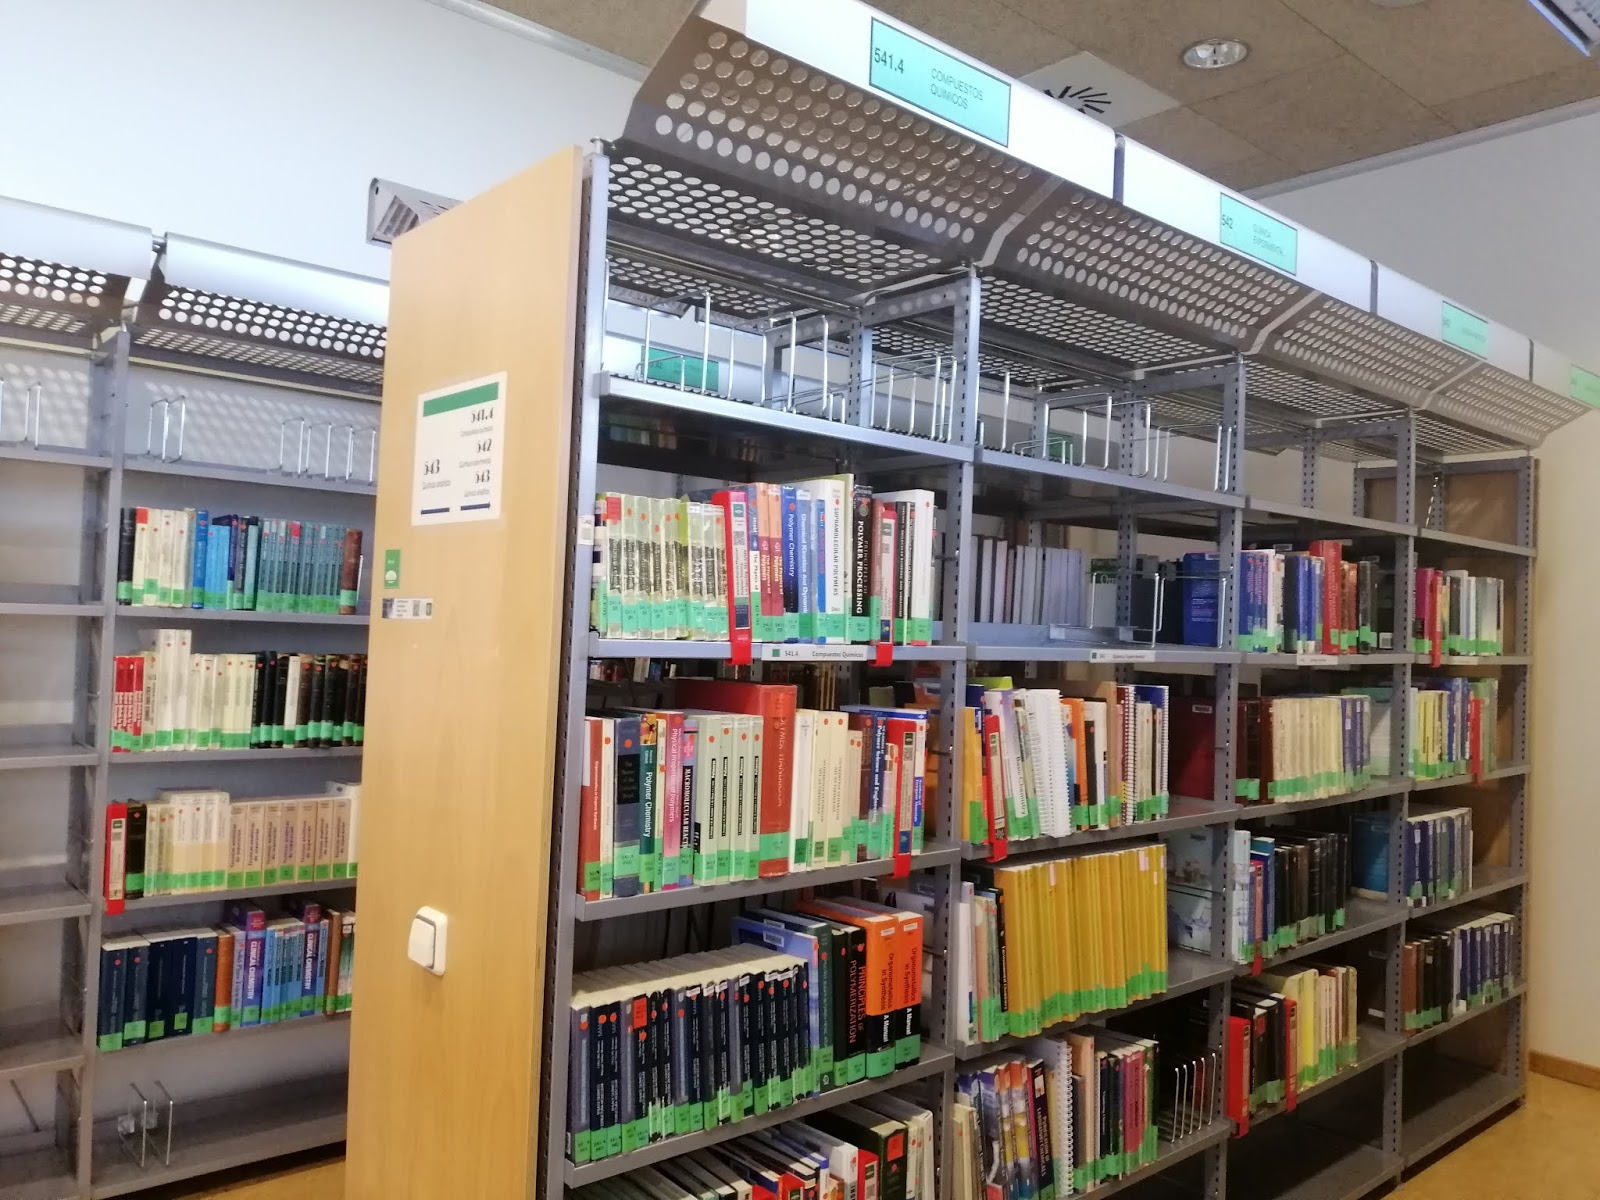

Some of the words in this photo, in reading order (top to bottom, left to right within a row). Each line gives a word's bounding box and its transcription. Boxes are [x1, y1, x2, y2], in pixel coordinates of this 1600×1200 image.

[874, 47, 904, 74] 541.4
[931, 68, 983, 100] COMPUESTOS
[1222, 214, 1233, 229] 542
[471, 407, 494, 423] 541.4
[476, 438, 492, 453] 542
[423, 459, 440, 475] 543
[475, 469, 490, 484] 543
[787, 513, 795, 541] Polymer
[800, 513, 808, 544] Chemical
[832, 507, 840, 563] SUPRAMOLECULAR
[788, 543, 796, 577] Chemistry
[856, 561, 864, 614] PROCESSING
[670, 728, 678, 755] Physical
[644, 772, 652, 800] Polymer
[683, 768, 691, 825] MACROMOLECULAR
[1018, 776, 1027, 815] Chemistry
[644, 802, 652, 838] Chemistry
[668, 794, 676, 822] Polymers
[872, 786, 880, 824] Engineering
[249, 941, 257, 967] CLINICAL
[306, 933, 314, 958] CLINICAL
[247, 967, 256, 1000] CHEMISTRY
[305, 958, 314, 990] CHEMISTRY
[849, 960, 857, 1043] POLYMERIZATION
[858, 966, 866, 1019] PRINCIPLES
[1036, 1107, 1044, 1143] LABORATORY
